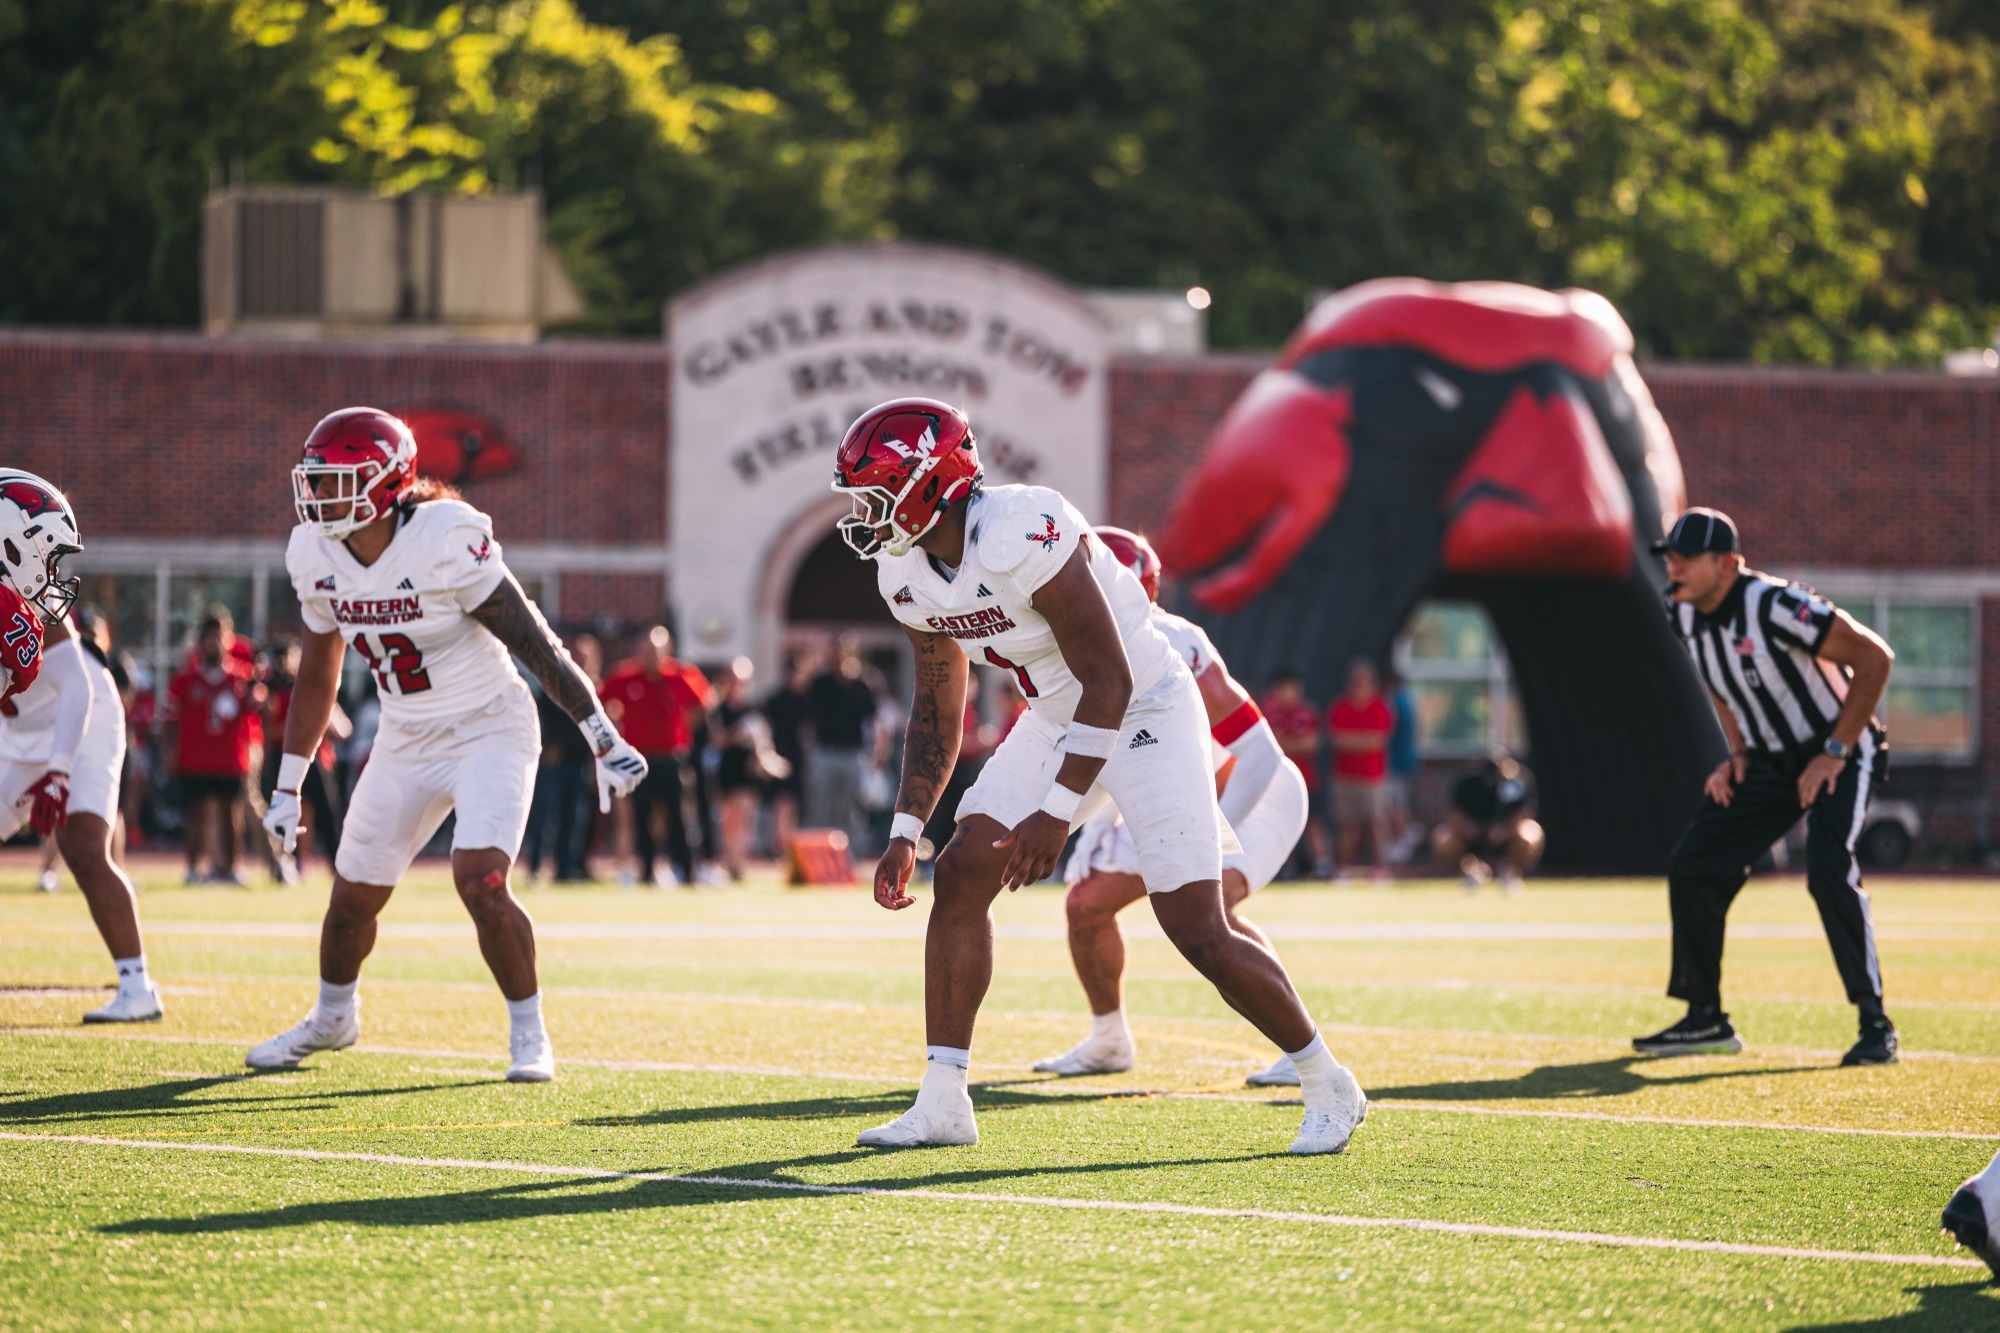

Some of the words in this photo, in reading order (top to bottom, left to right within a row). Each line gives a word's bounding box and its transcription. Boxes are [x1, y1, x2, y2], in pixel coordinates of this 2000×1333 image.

[865, 298, 969, 341] AND
[329, 595, 420, 615] EASTERN
[334, 609, 424, 626] WASHINGTON
[926, 605, 1007, 630] EASTERN
[4, 612, 41, 669] 73
[352, 632, 432, 696] 12
[1129, 737, 1159, 749] adidas
